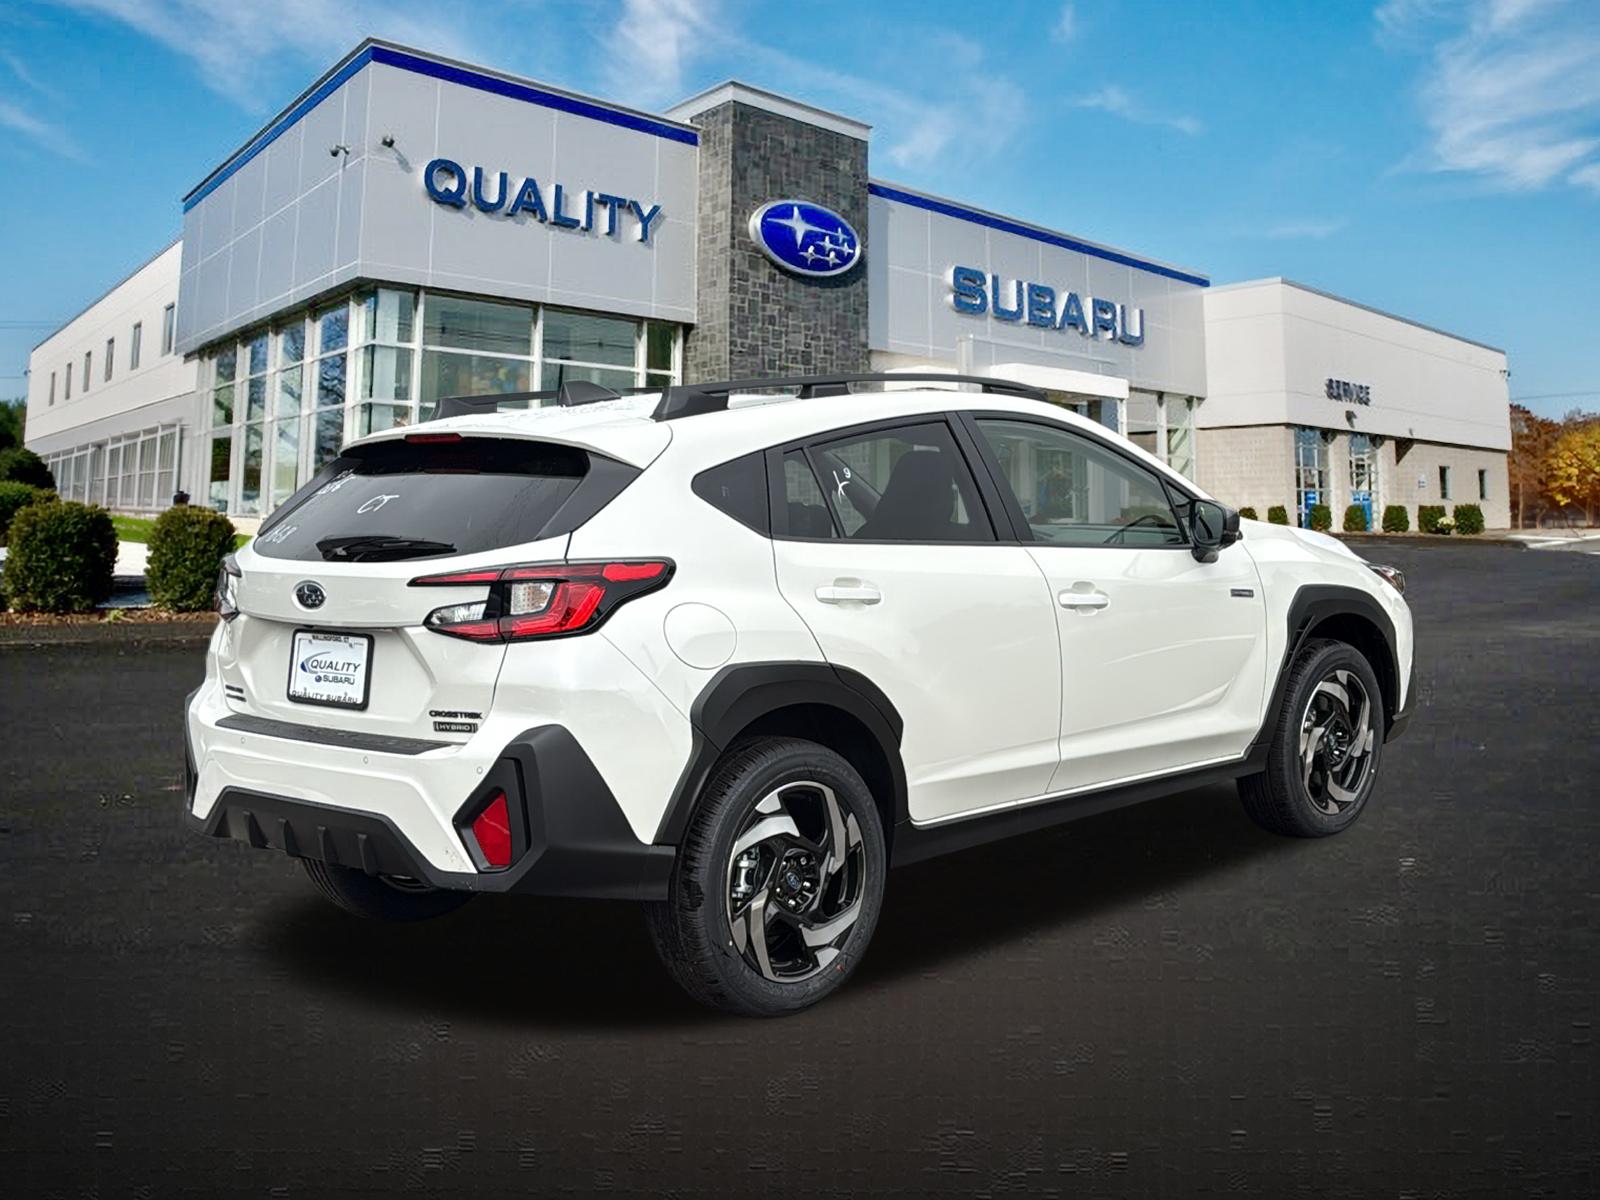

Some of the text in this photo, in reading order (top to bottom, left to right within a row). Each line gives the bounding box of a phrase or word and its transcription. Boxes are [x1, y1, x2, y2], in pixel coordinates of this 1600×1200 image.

[424, 158, 661, 242] QUALITY
[950, 265, 1146, 346] SUBARU
[1324, 378, 1371, 406] SERVICE
[310, 659, 361, 673] QUALITY
[322, 674, 355, 686] SUBARU
